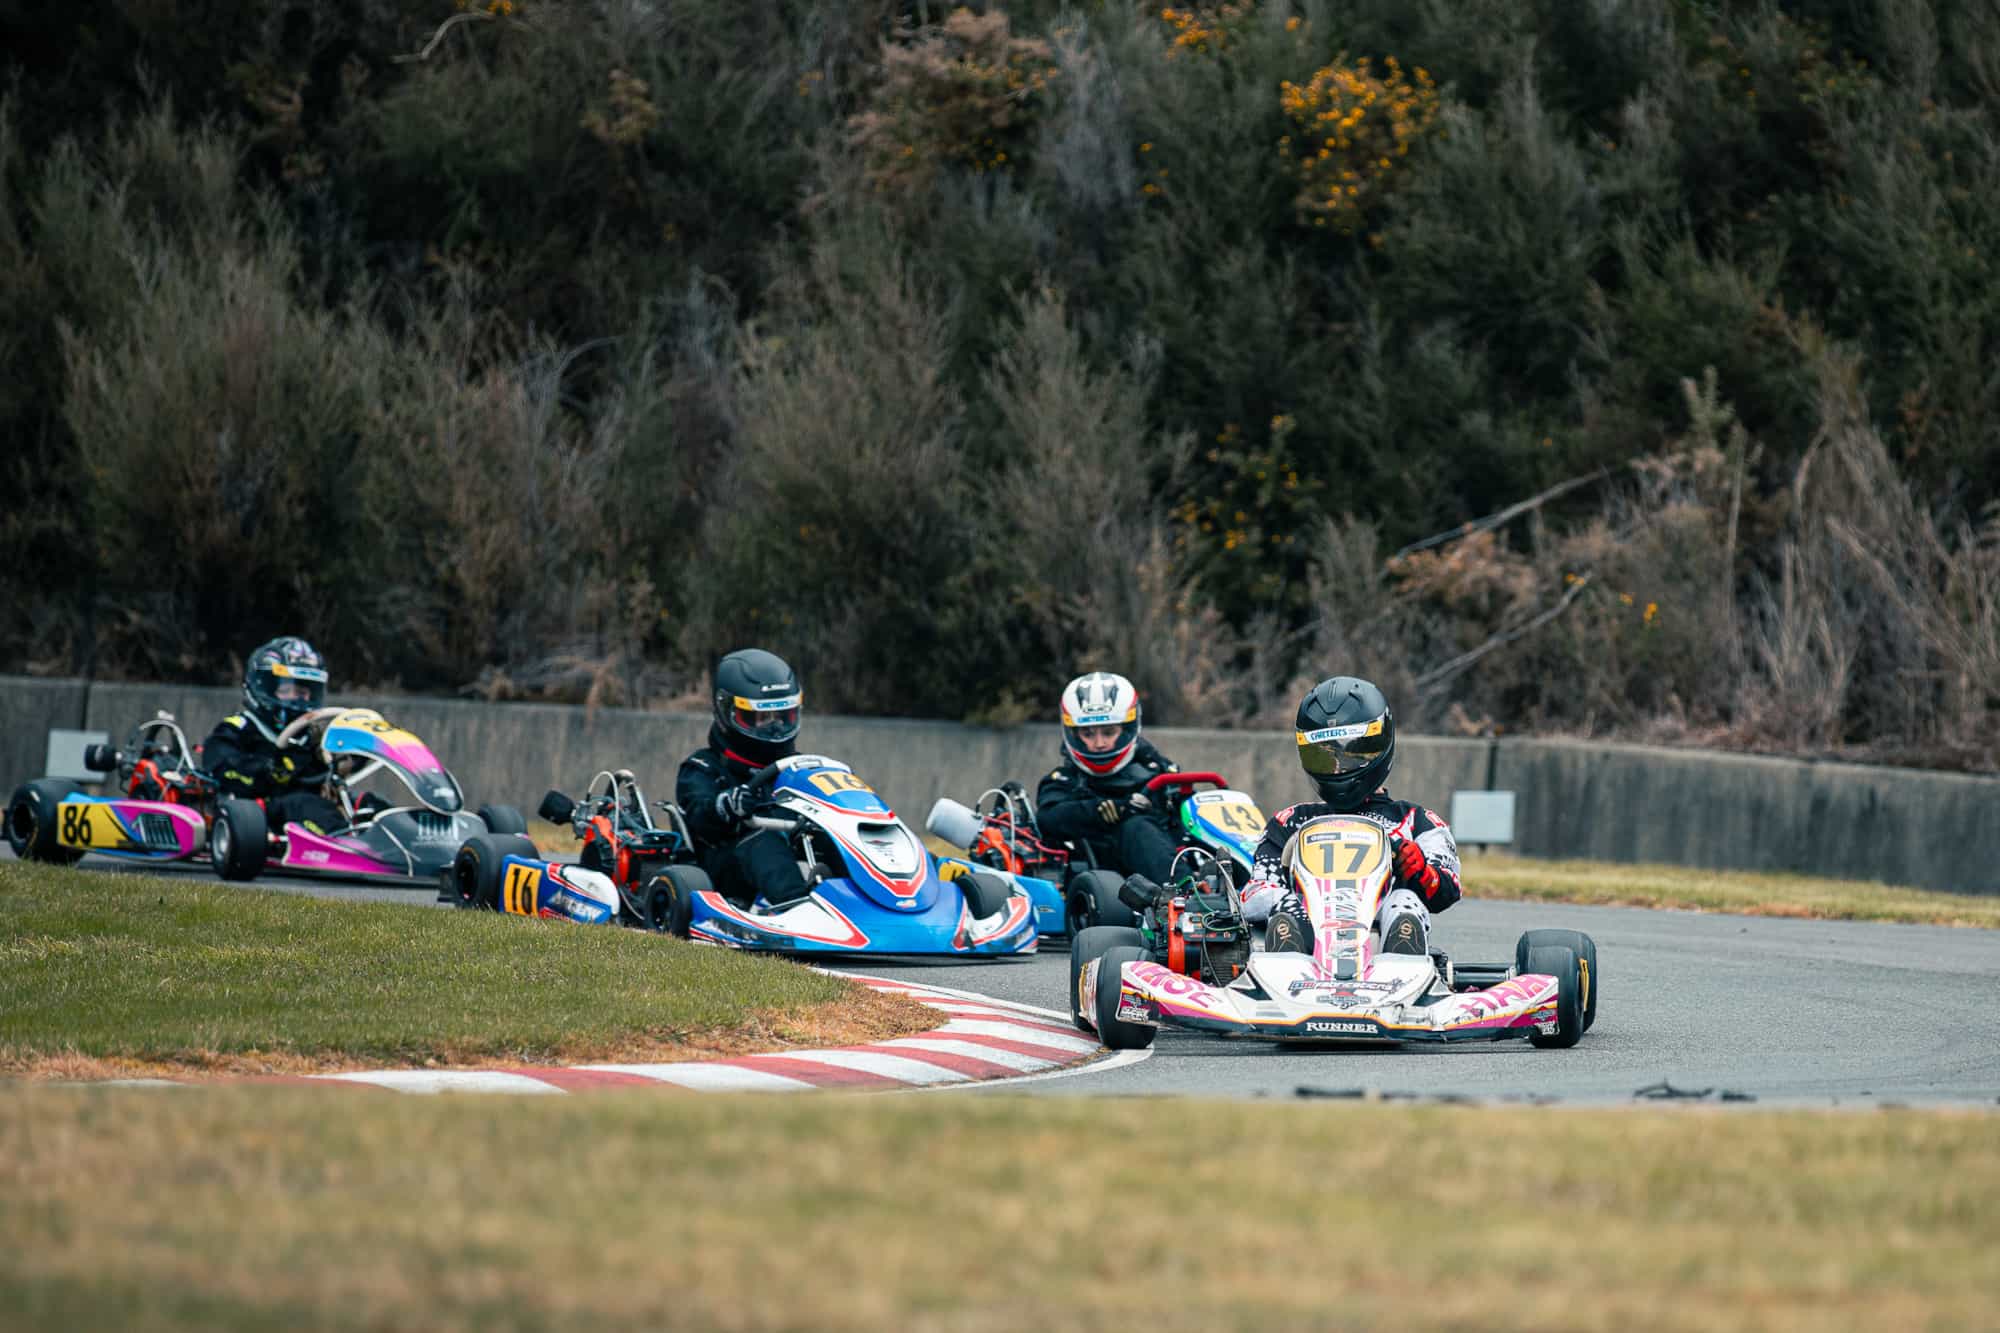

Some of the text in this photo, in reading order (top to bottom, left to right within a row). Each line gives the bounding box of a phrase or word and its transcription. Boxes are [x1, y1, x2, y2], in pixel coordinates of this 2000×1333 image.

[817, 774, 868, 791] 16
[63, 804, 92, 846] 86
[1221, 804, 1262, 831] 43
[1319, 843, 1372, 874] 17
[511, 867, 534, 915] 16
[1305, 1021, 1379, 1035] RUNNER
